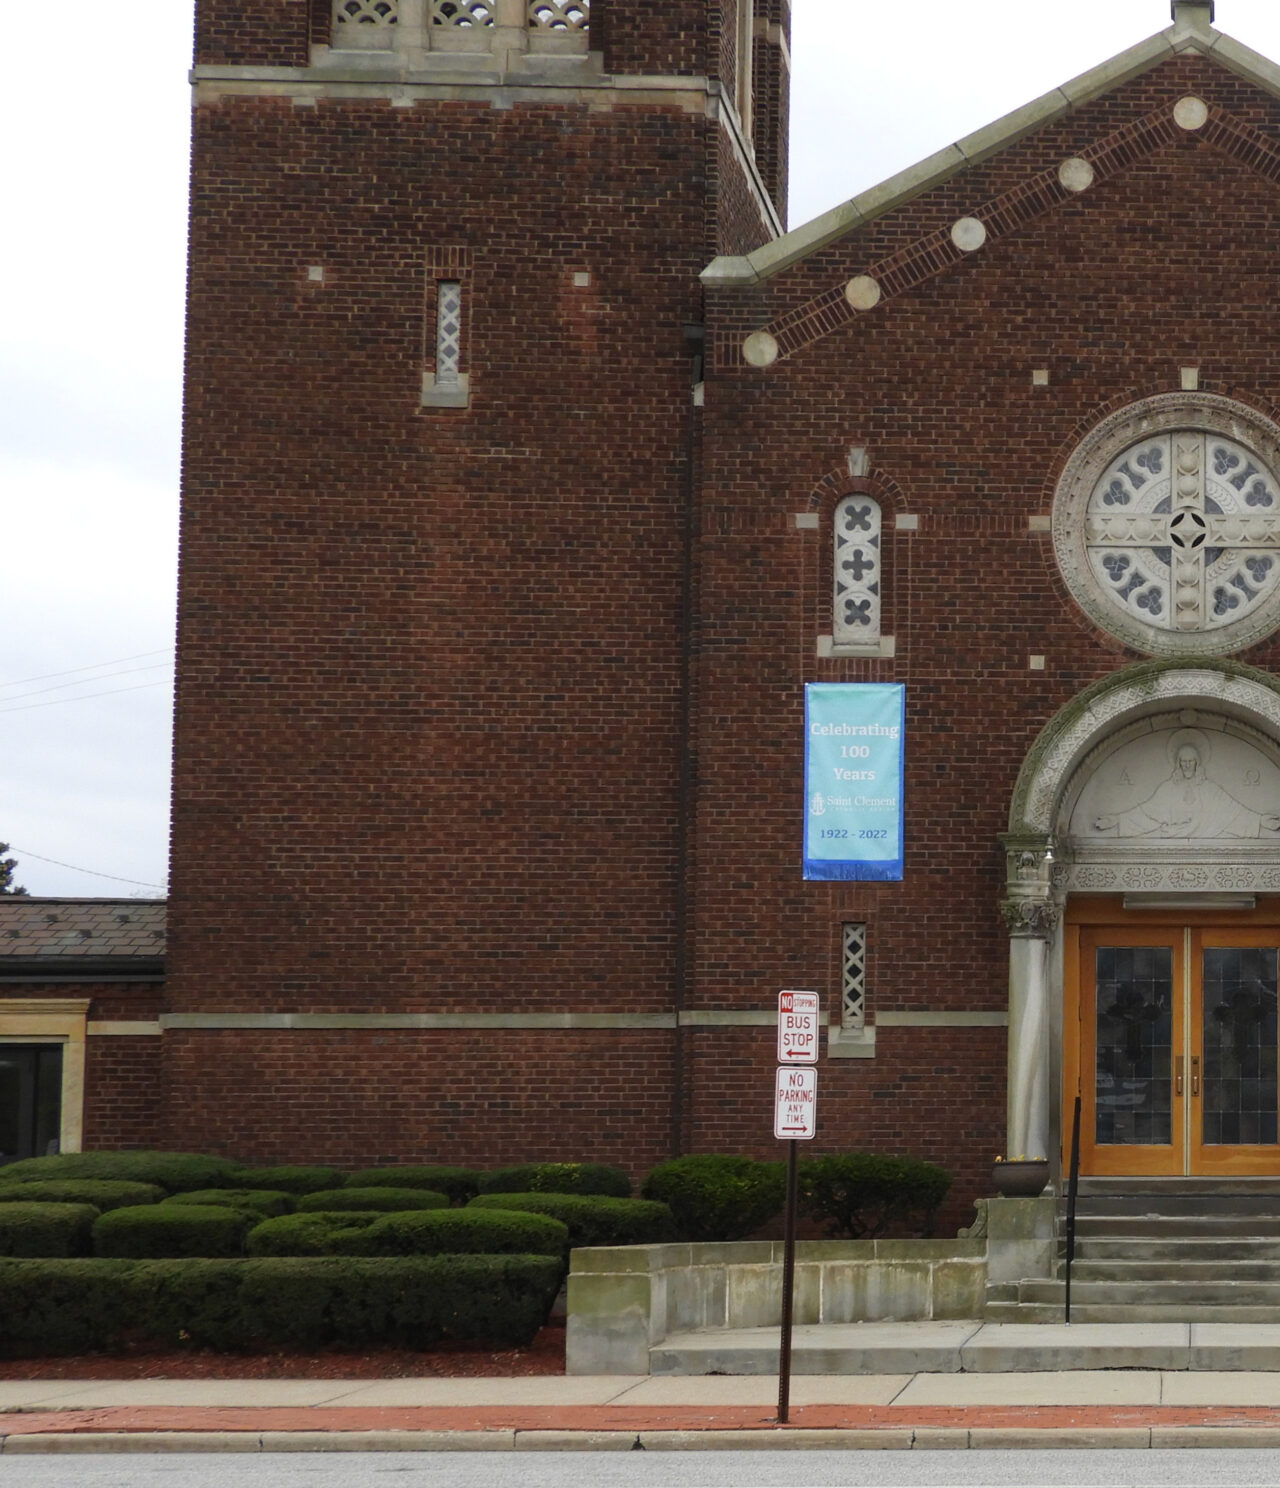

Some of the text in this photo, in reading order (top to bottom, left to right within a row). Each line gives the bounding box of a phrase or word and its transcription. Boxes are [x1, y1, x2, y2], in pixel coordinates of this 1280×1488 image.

[810, 722, 899, 739] Celebrating
[840, 745, 870, 758] 100
[833, 767, 876, 781] Years
[827, 795, 896, 806] Saint Clement
[820, 829, 848, 839] 1922
[858, 829, 888, 839] 2022
[781, 995, 816, 1009] NO STOPPING
[786, 1015, 811, 1029] BUS
[783, 1033, 814, 1046] STOP
[789, 1073, 804, 1087] NO
[779, 1089, 813, 1103] PARKING
[787, 1104, 803, 1113] ANY
[786, 1114, 804, 1124] TIME
